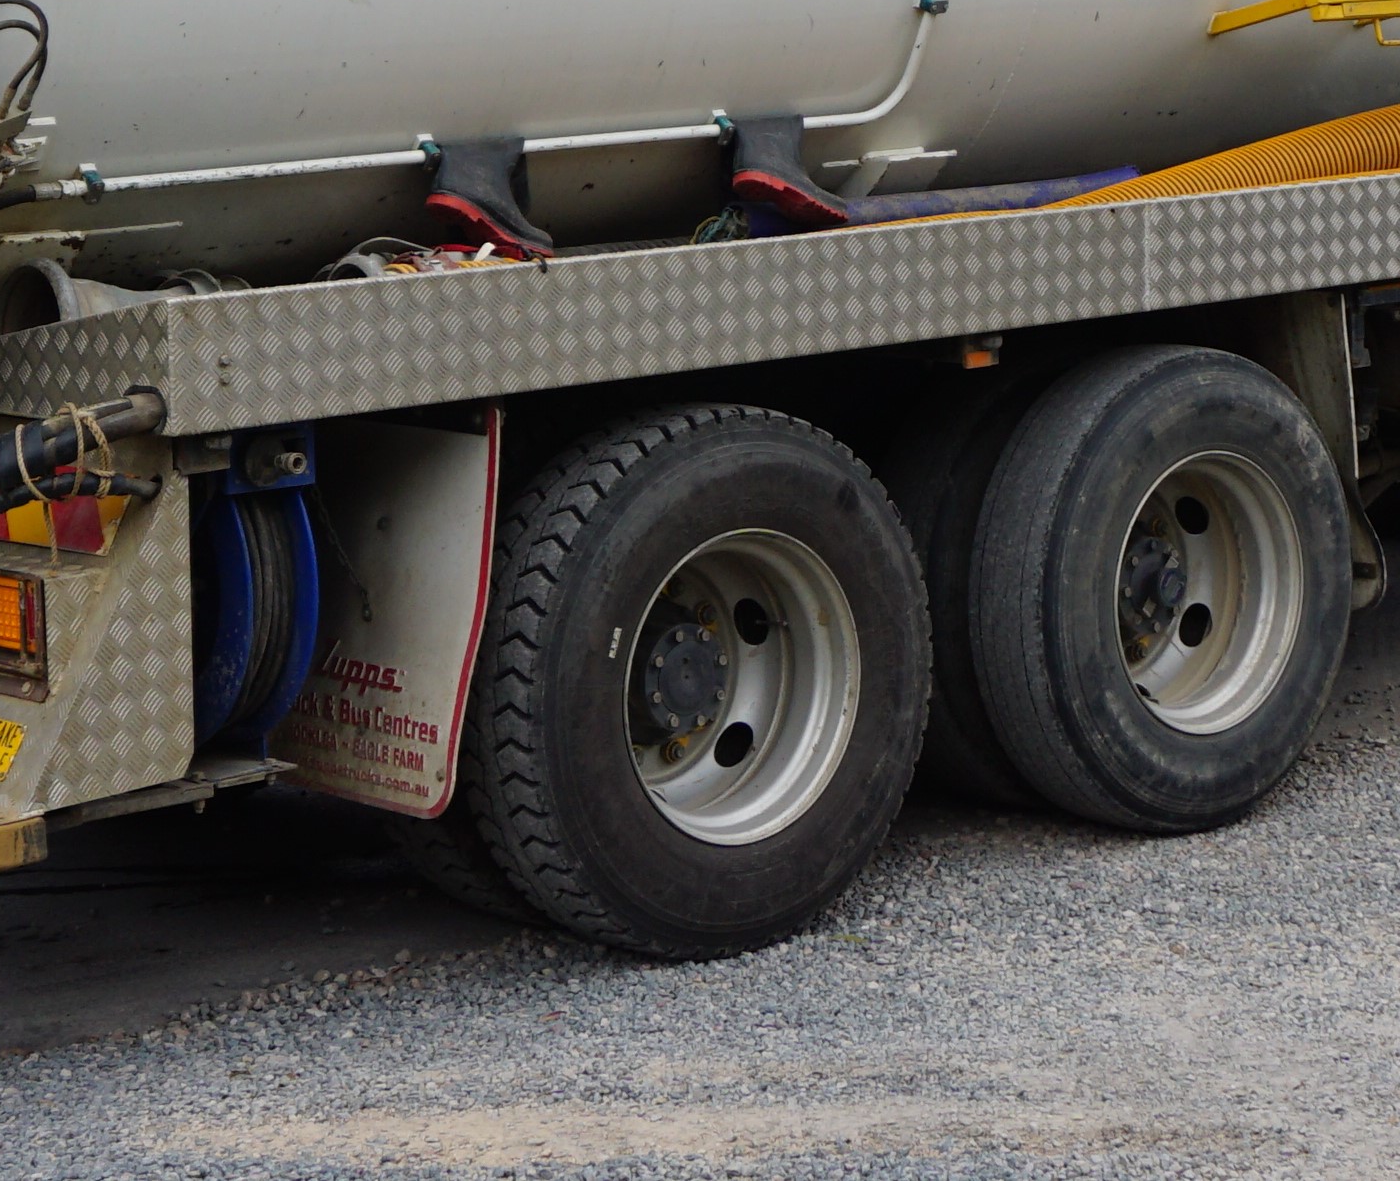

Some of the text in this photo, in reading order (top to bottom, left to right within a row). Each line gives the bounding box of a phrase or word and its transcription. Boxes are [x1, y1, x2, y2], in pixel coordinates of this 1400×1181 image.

[339, 698, 371, 727] Bus
[374, 706, 439, 745] Centres
[393, 747, 424, 773] FARM
